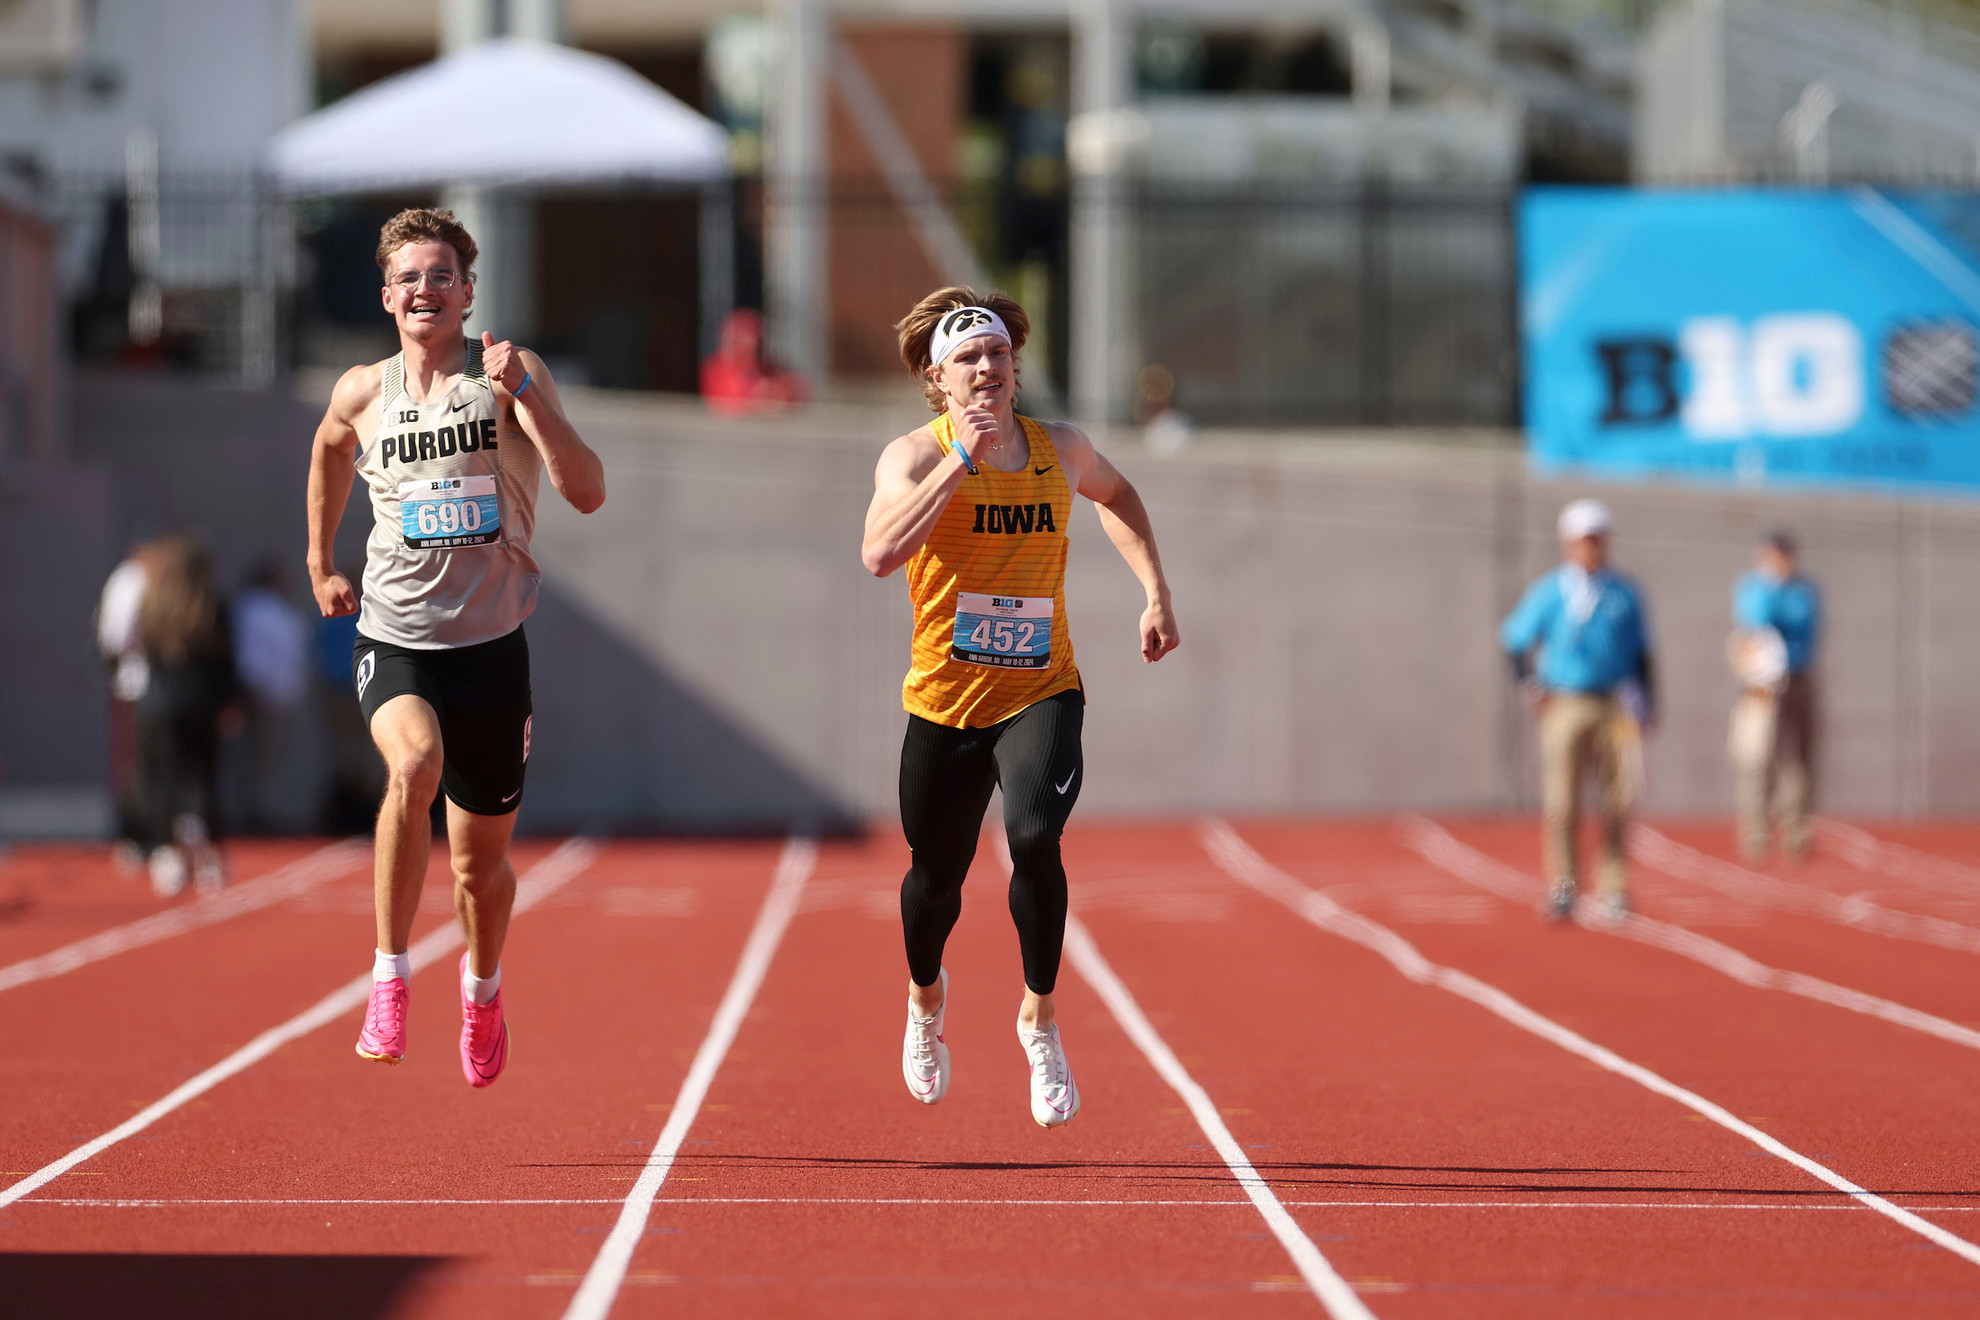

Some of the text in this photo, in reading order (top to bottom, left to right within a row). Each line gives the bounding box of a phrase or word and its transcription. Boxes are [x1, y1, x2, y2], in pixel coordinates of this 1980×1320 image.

[382, 419, 498, 469] PURDUE
[418, 501, 482, 535] 690
[973, 503, 1056, 534] IOWA
[970, 619, 1035, 652] 452
